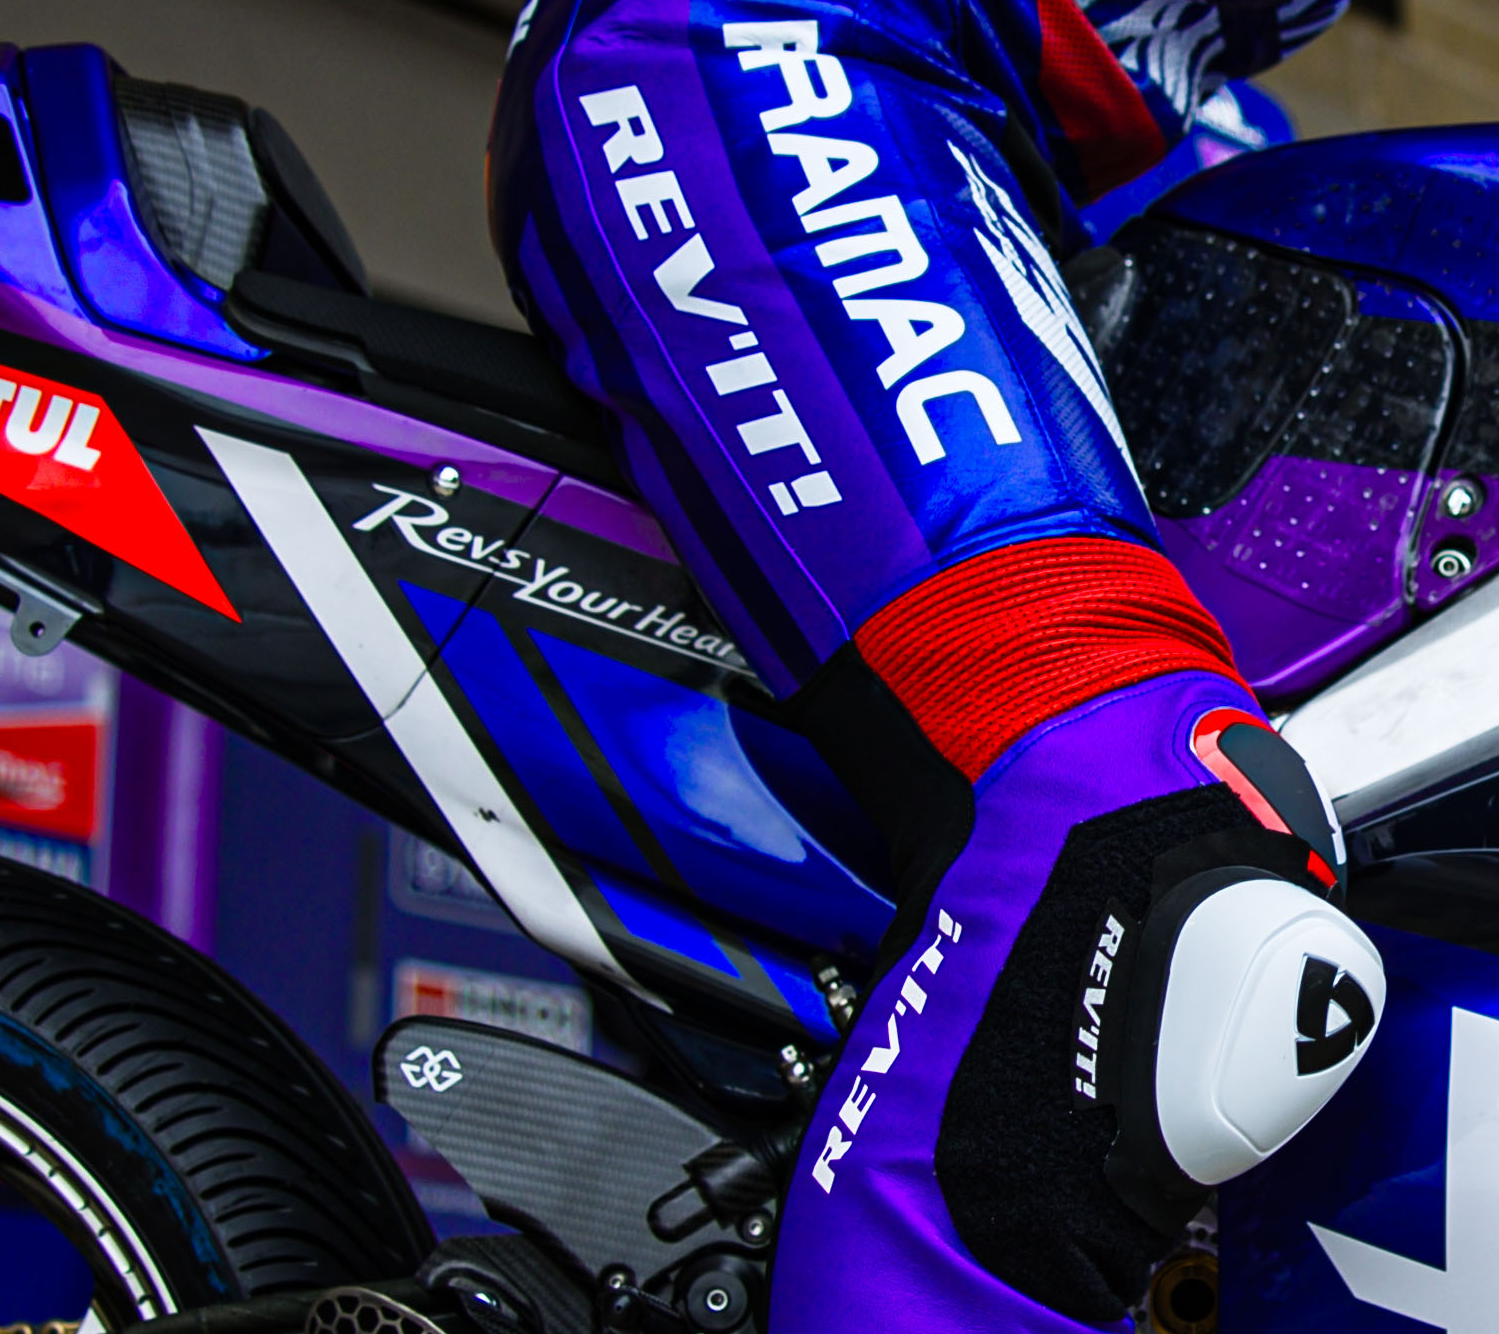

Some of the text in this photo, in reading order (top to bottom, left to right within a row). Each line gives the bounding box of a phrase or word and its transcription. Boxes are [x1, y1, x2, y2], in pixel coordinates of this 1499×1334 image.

[579, 84, 842, 515] REV'IT!
[636, 605, 747, 662] Hear
[811, 907, 963, 1195] REV'IT!
[1071, 913, 1126, 1101] REV'IT!
